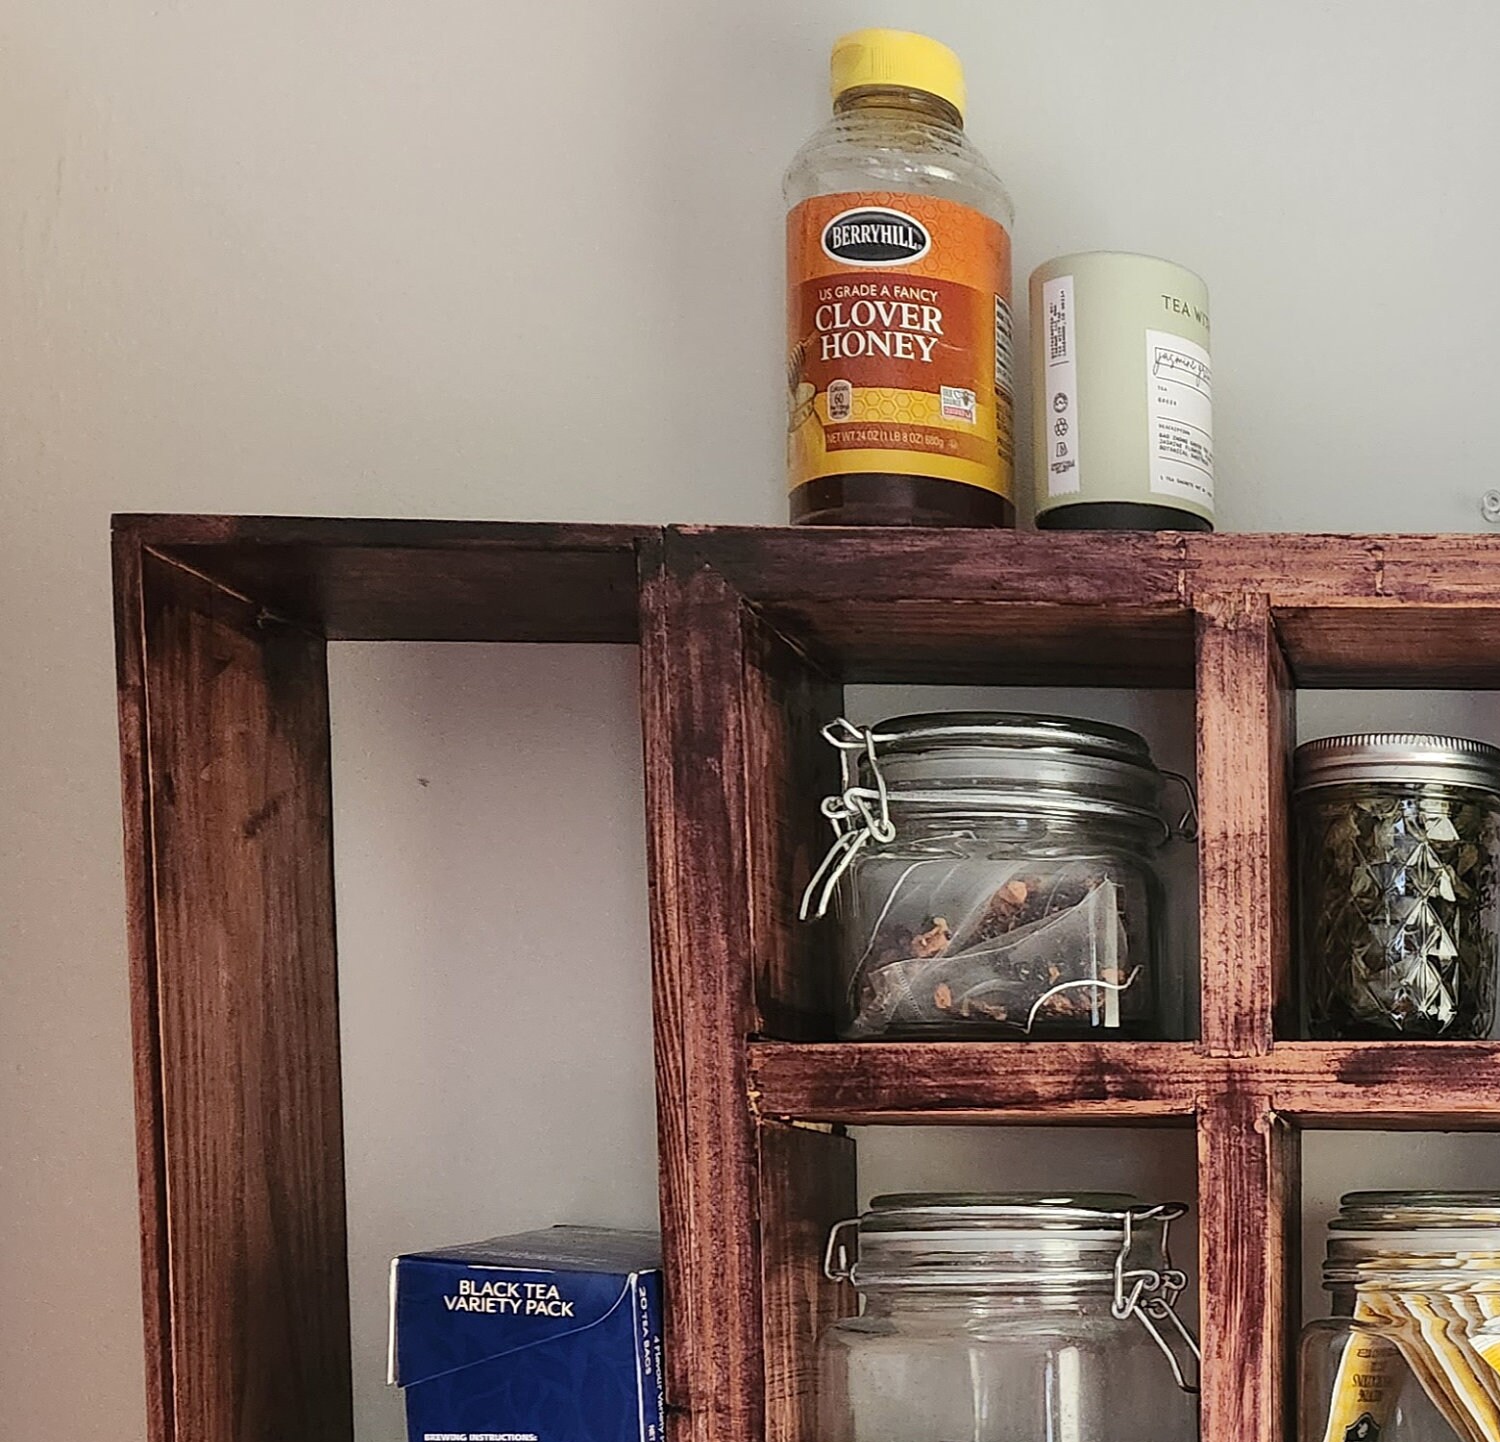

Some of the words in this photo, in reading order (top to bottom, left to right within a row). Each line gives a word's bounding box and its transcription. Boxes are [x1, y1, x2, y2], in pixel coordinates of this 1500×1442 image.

[832, 224, 917, 251] BERRYHILL
[819, 289, 833, 300] US
[835, 284, 877, 299] GRADE
[880, 285, 890, 297] A
[893, 286, 938, 302] FANCY
[815, 299, 944, 335] CLOVER
[1161, 295, 1191, 317] TEA
[820, 330, 938, 363] HONEY
[856, 431, 866, 441] 24
[866, 431, 879, 441] OZ
[889, 431, 900, 441] LB
[459, 1279, 521, 1298] BLACK
[524, 1282, 560, 1300] TEA
[639, 1286, 648, 1310] 20
[443, 1295, 524, 1315] VARIETY
[525, 1300, 575, 1318] PACK
[641, 1312, 650, 1338] TEA
[643, 1339, 652, 1375] BAGS
[424, 1433, 467, 1441] BREWING
[469, 1433, 538, 1441] INSTRUCTIONS:
